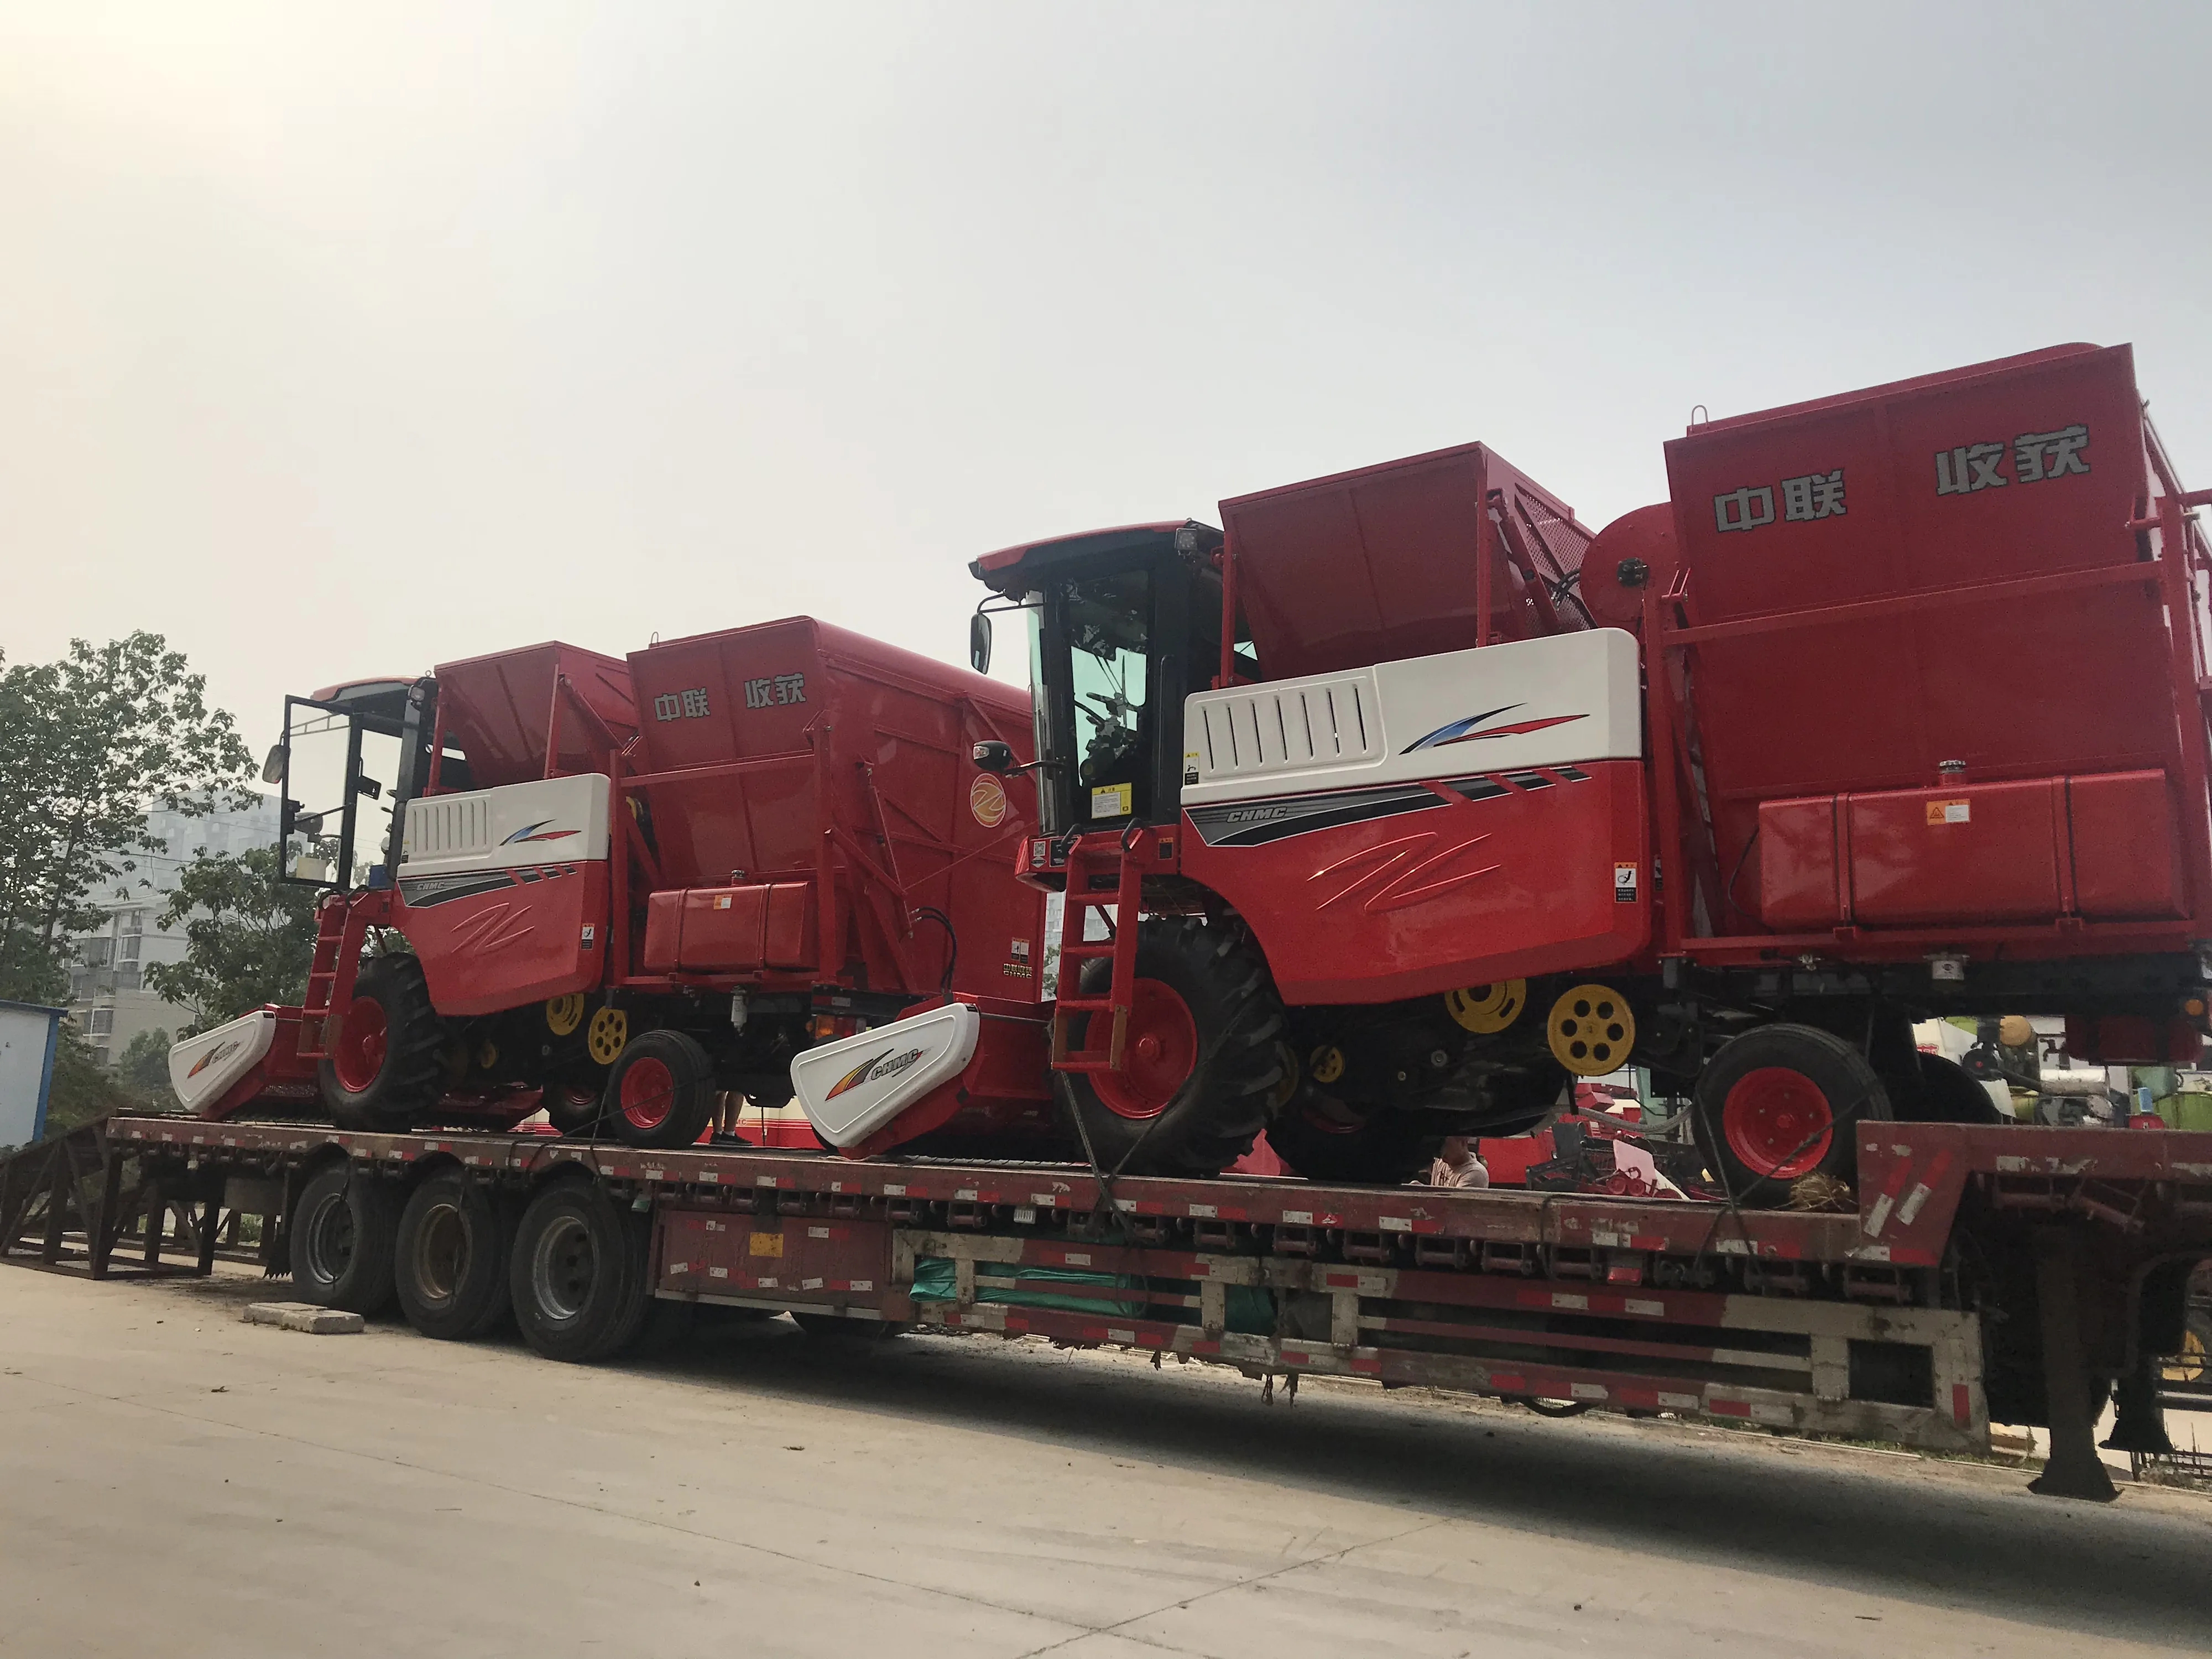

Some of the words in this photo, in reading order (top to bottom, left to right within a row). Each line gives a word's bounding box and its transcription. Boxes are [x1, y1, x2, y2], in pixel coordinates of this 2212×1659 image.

[1713, 468, 1848, 533] 中联
[1936, 424, 2090, 495] 收获
[654, 687, 711, 721] 中联
[744, 672, 806, 708] 收获
[1227, 806, 1287, 823] CHMC
[871, 1048, 919, 1081] CHMC
